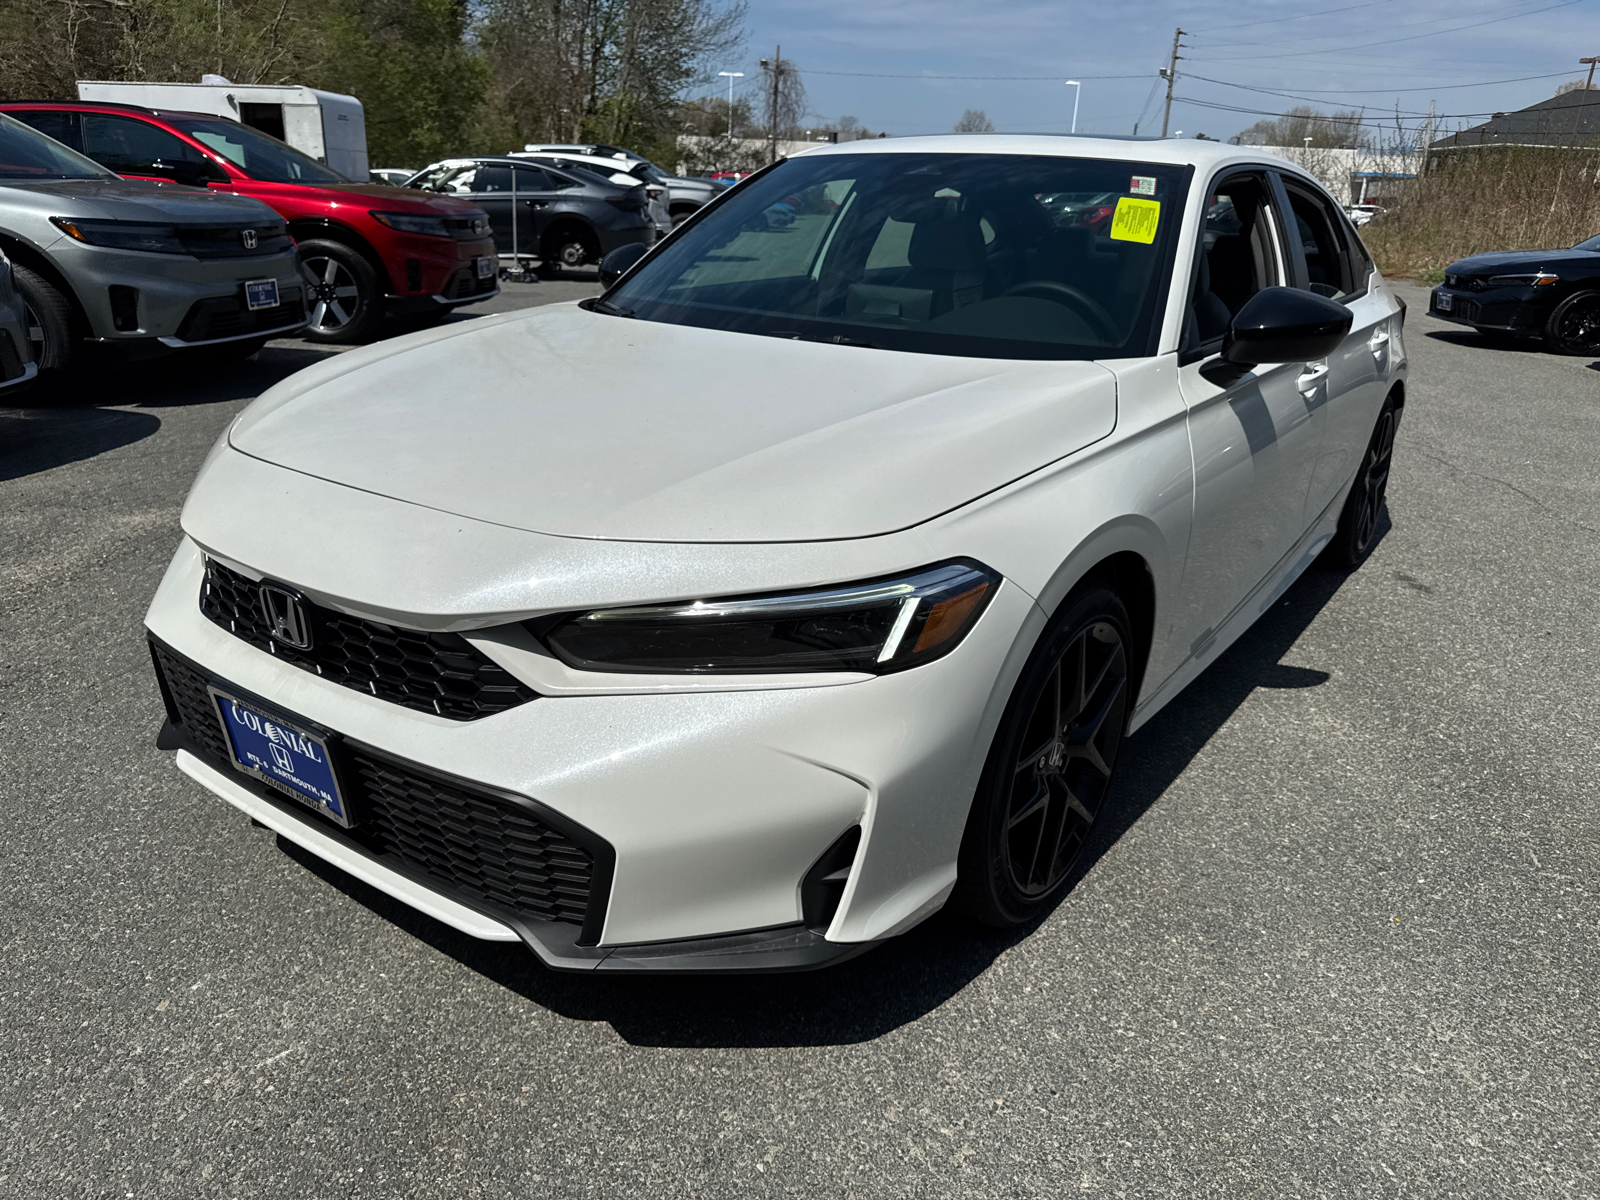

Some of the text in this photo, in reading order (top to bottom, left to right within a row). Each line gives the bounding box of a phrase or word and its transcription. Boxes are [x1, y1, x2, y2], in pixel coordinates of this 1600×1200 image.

[231, 704, 322, 763] COLONIAL
[261, 774, 322, 812] COLONIAL HONDA
[320, 790, 333, 803] MA
